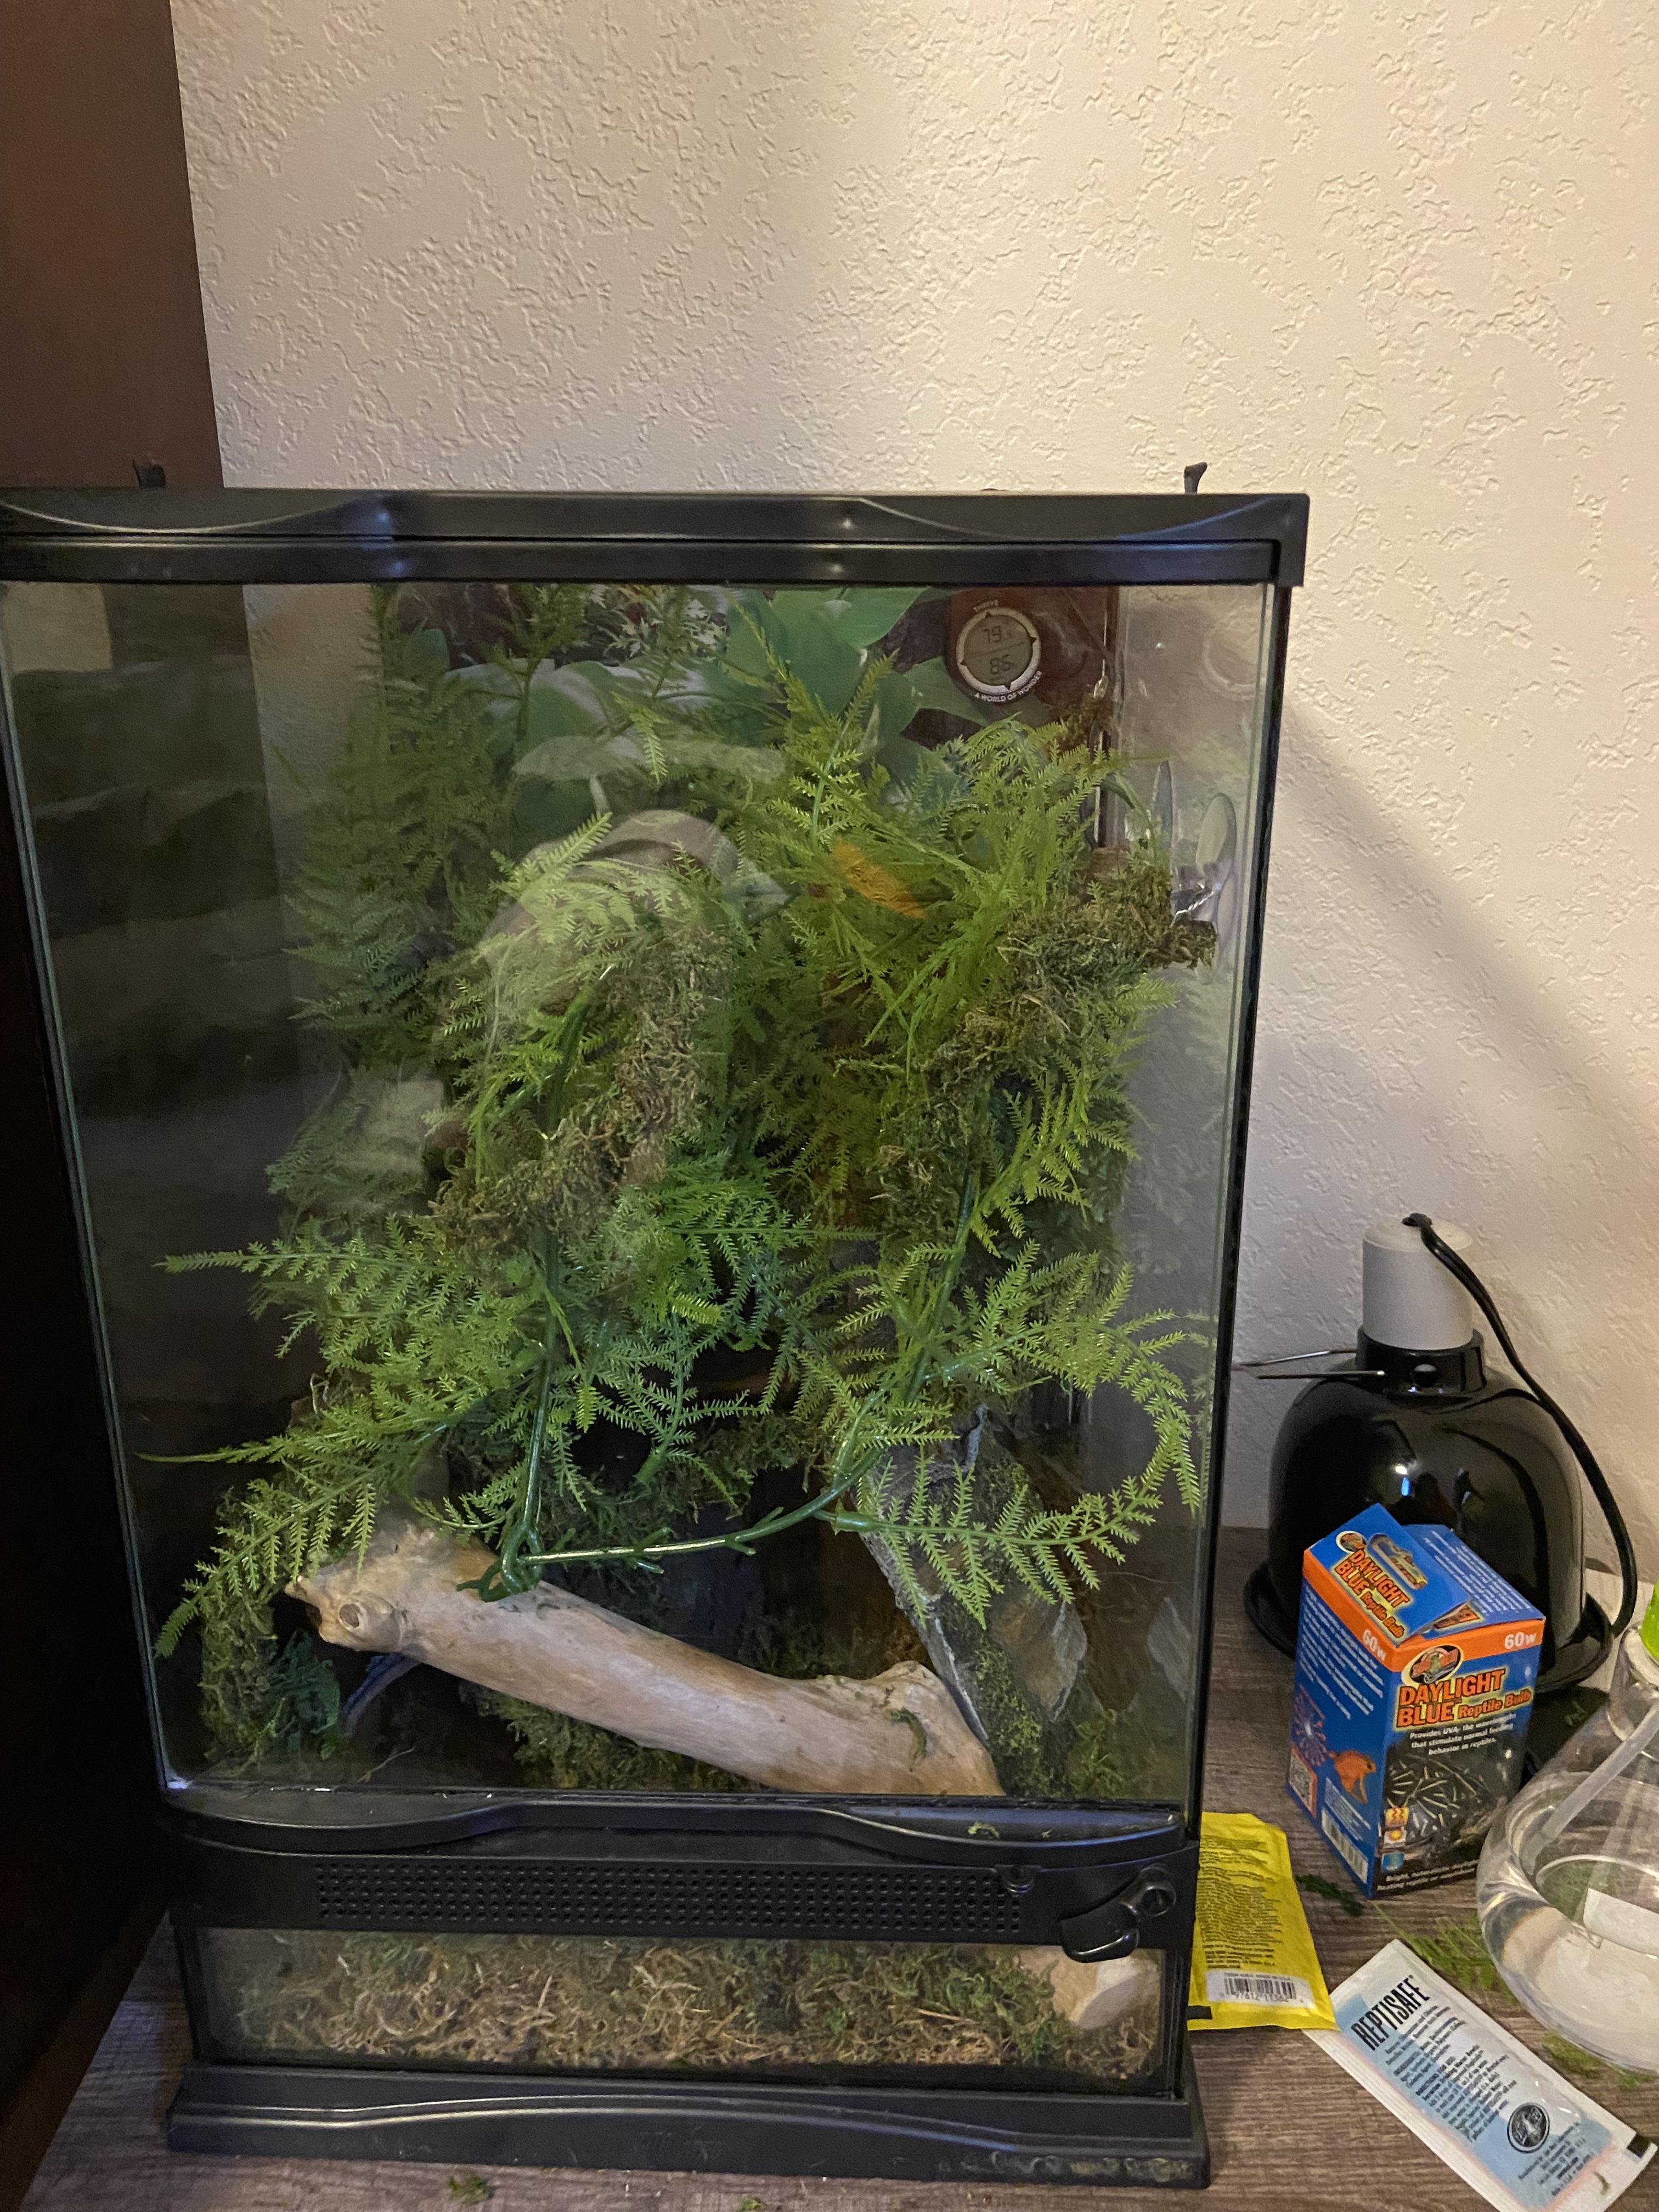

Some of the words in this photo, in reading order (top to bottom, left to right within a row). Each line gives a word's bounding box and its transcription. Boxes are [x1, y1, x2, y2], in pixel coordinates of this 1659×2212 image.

[1018, 670, 1042, 696] WONDER
[1349, 1549, 1410, 1607] DAYLIGHT
[1335, 1560, 1370, 1595] BLUE
[1360, 1590, 1388, 1621] Reptile
[1383, 1615, 1406, 1638] Bulb
[1400, 1669, 1505, 1706] DAYLIGHT
[1397, 1701, 1455, 1728] BLUE
[1458, 1698, 1503, 1720] Reptile
[1504, 1688, 1532, 1709] Bulb
[1410, 1729, 1442, 1739] Provides
[1411, 1740, 1426, 1748] that
[1429, 1736, 1463, 1747] stimulate
[1463, 1730, 1488, 1740] normal
[1428, 1745, 1459, 1756] behavior
